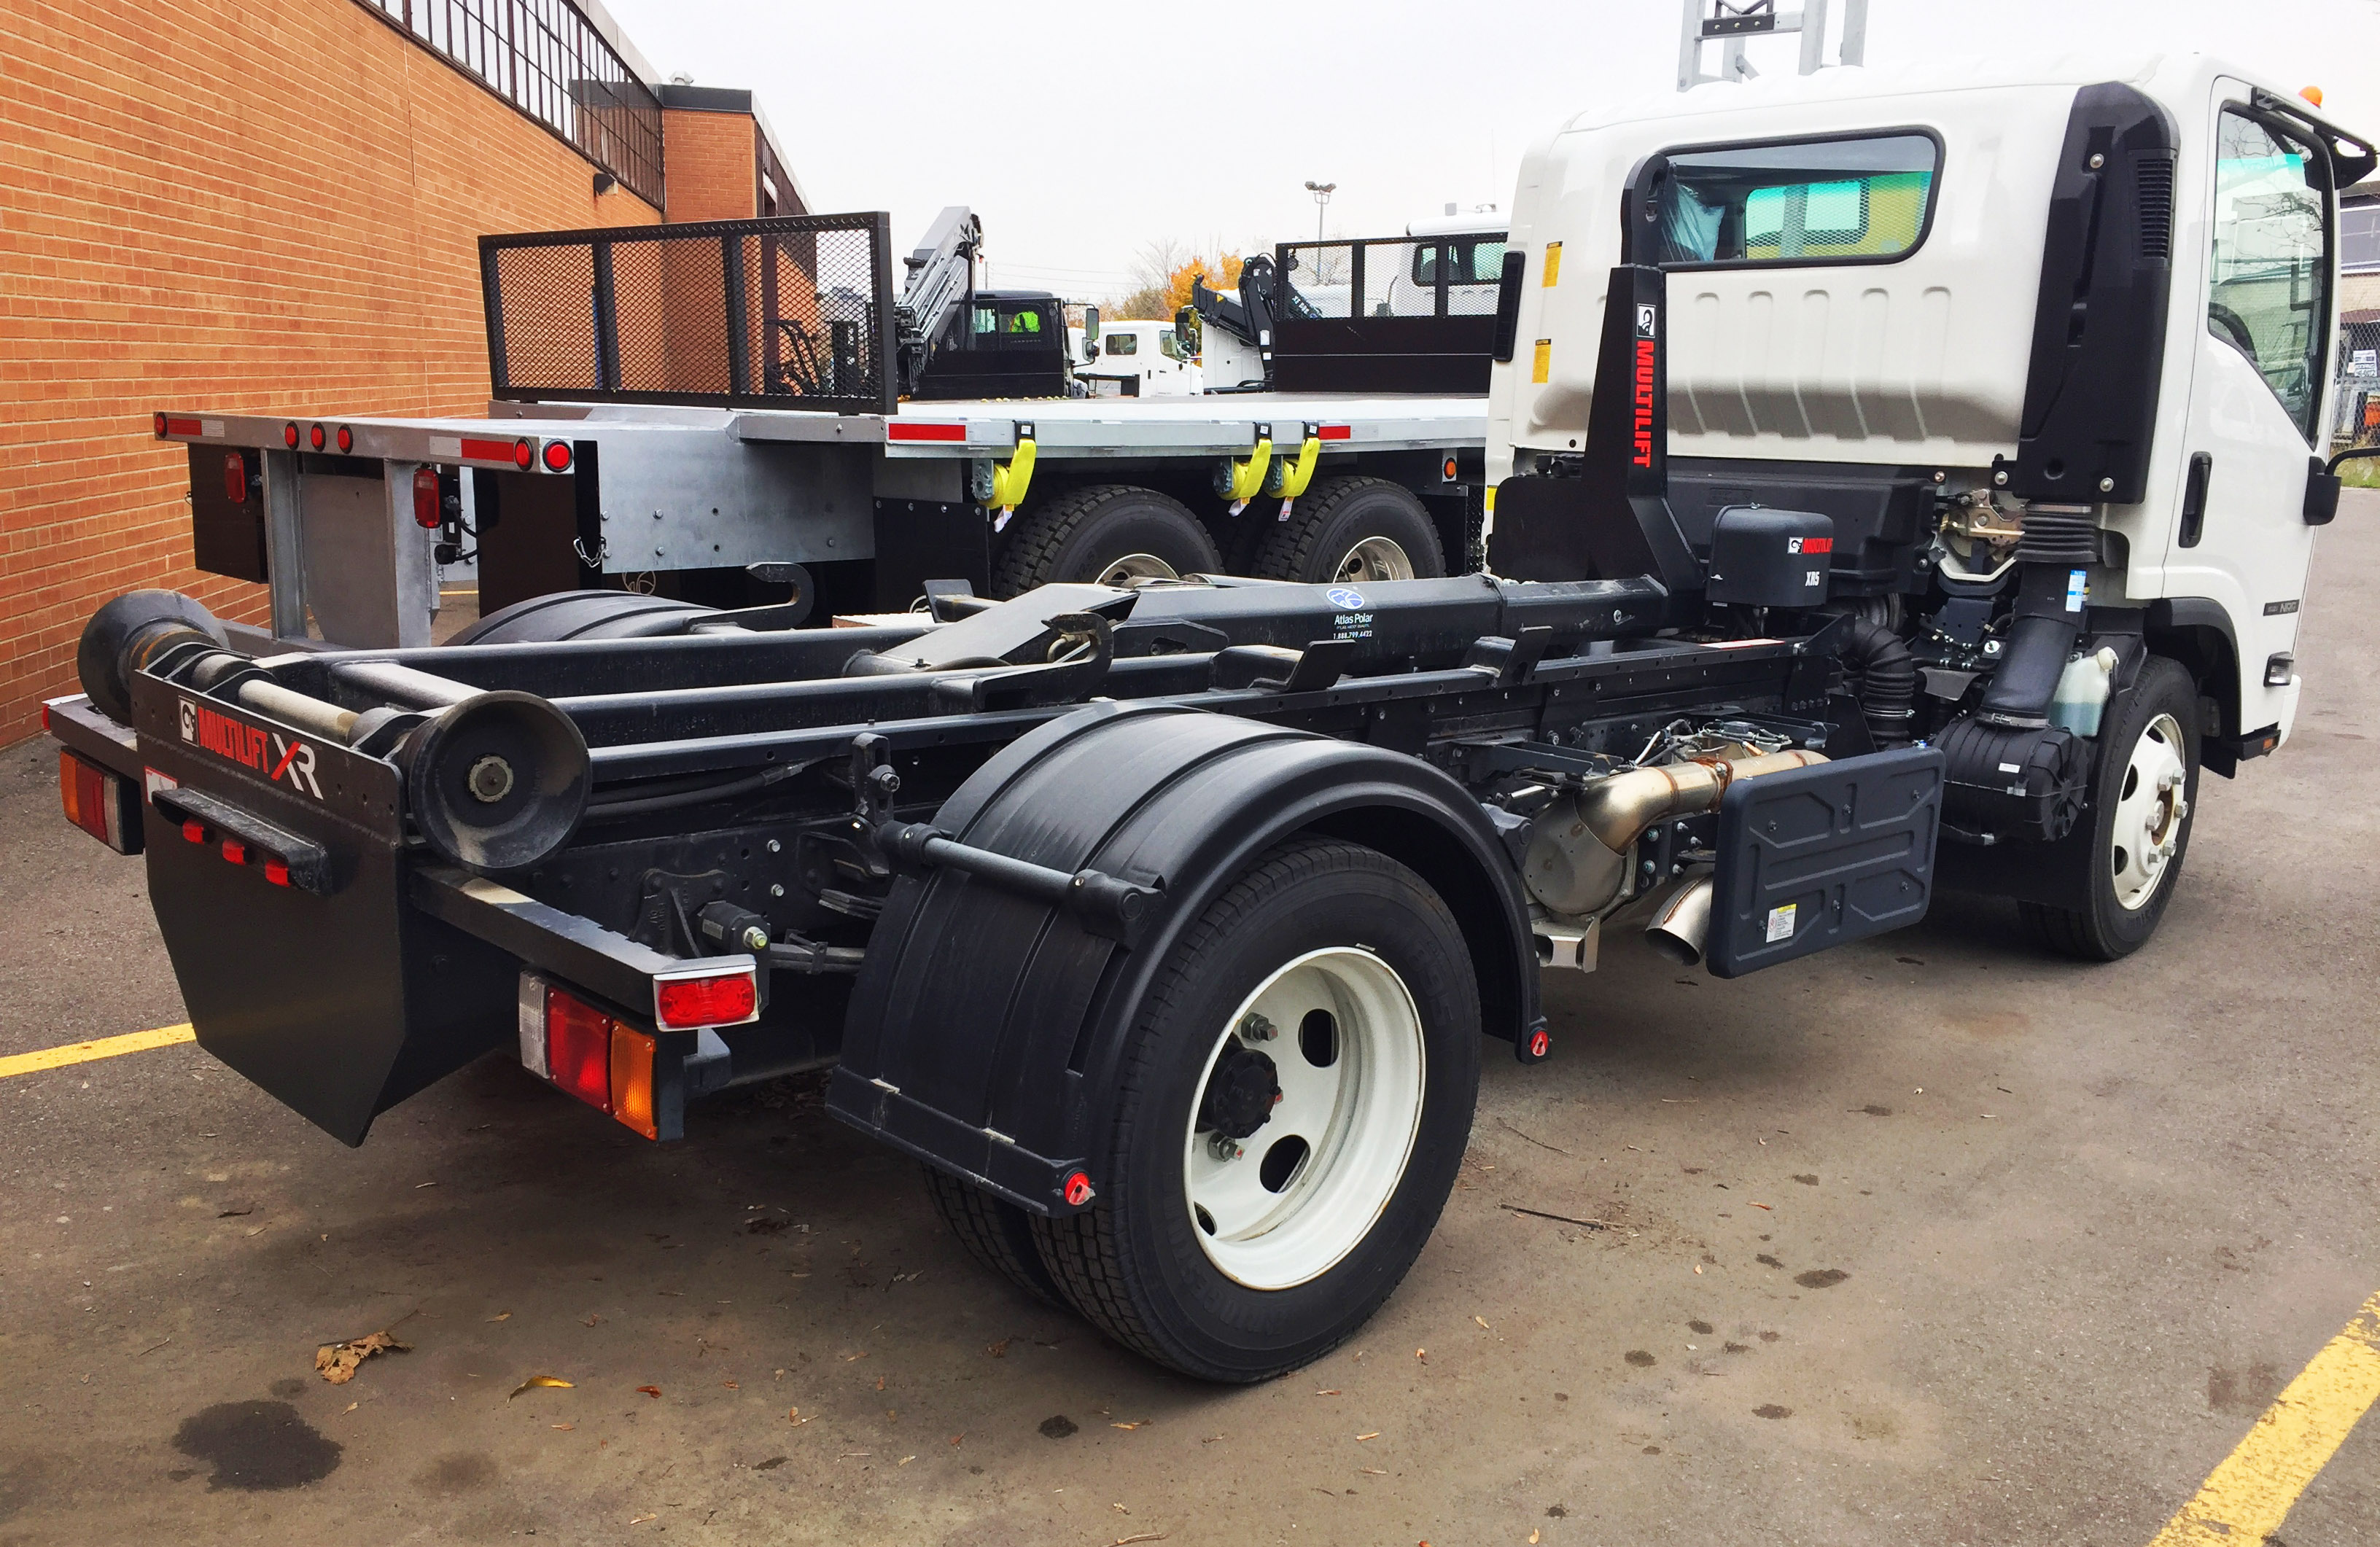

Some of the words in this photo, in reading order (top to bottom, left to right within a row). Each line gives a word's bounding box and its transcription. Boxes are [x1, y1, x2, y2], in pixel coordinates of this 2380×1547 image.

[1633, 340, 1654, 468] MULTILIFT
[1805, 571, 1820, 587] XR5
[1334, 615, 1353, 625] Atlas
[1355, 613, 1373, 623] Polar
[198, 706, 268, 774] MULTILIFT
[271, 733, 324, 800] XR
